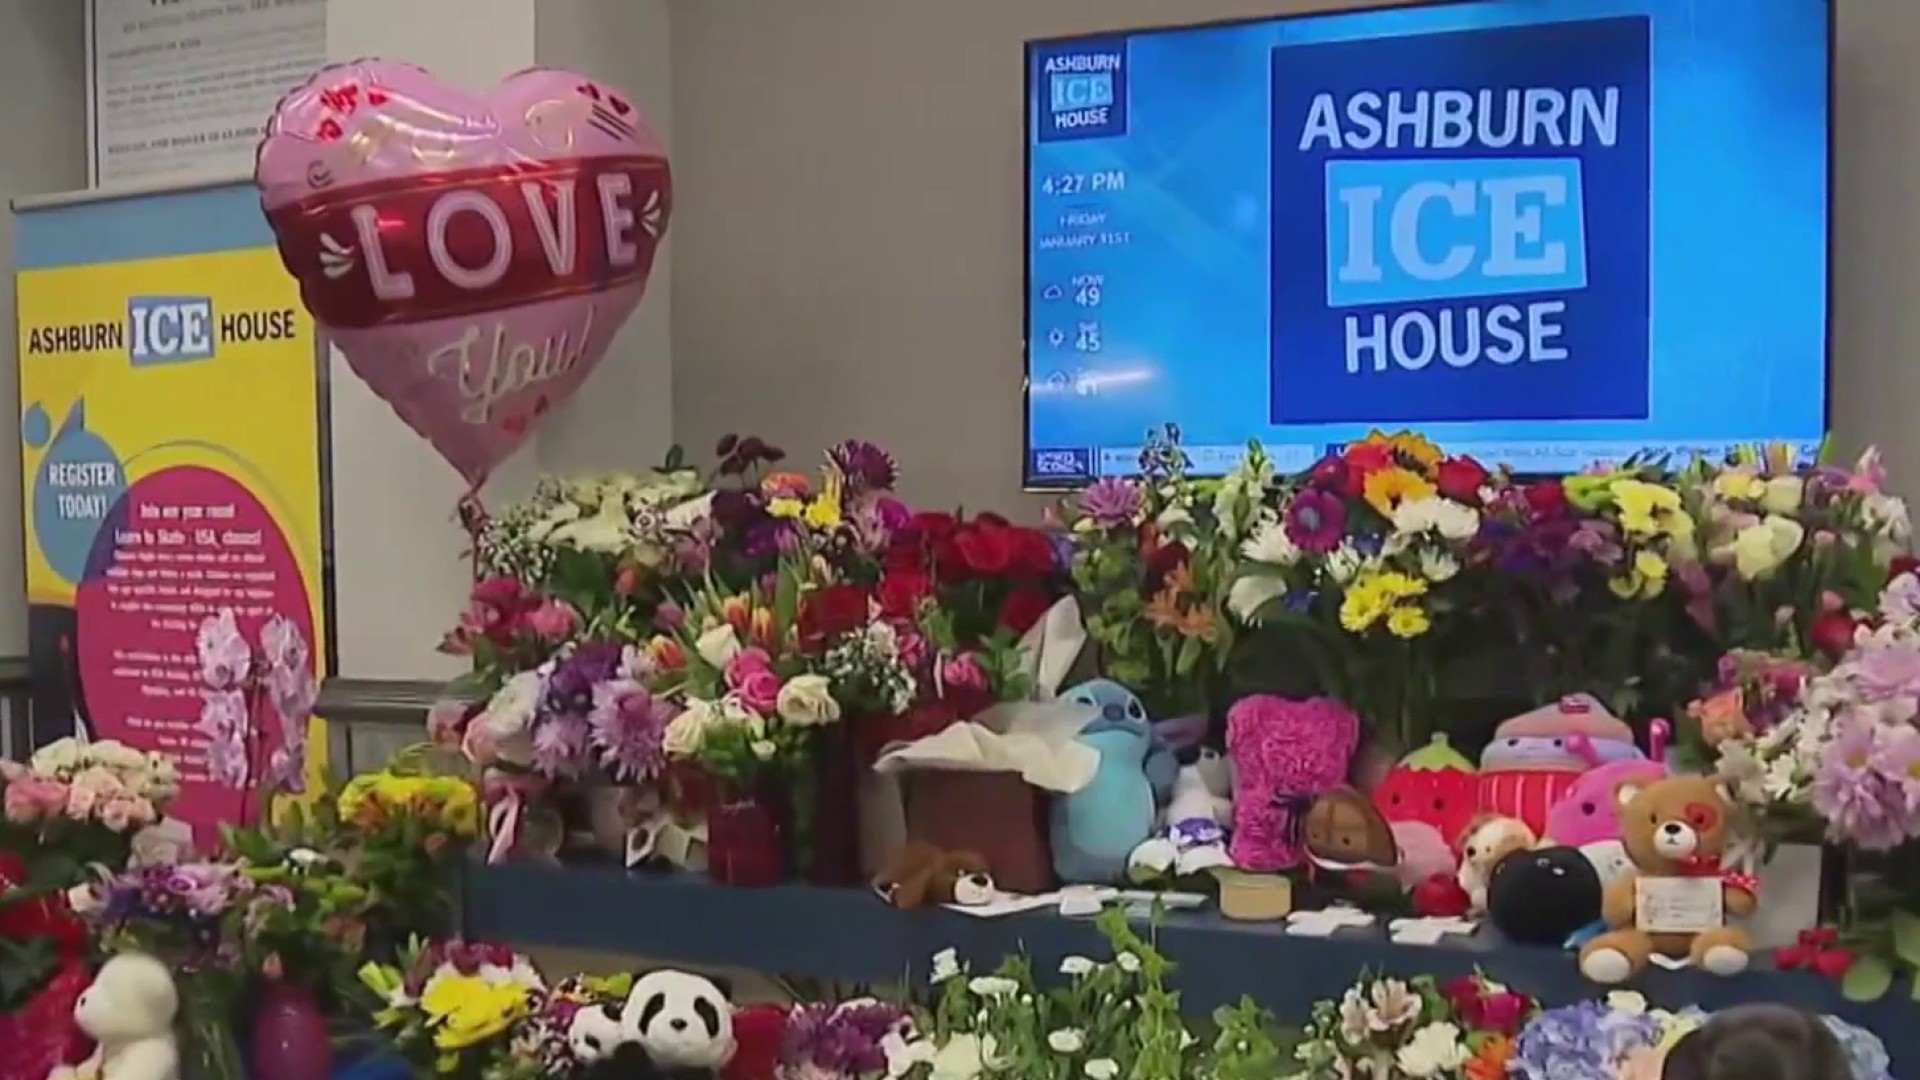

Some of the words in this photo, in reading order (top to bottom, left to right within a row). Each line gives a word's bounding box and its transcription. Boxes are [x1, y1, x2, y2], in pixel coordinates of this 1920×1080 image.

[1045, 53, 1120, 73] ASHBURN
[1055, 78, 1109, 107] ICE
[1055, 107, 1109, 129] HOUSE
[1299, 87, 1619, 151] ASHBURN
[1043, 174, 1085, 195] 4:27
[1092, 170, 1125, 191] PM
[351, 172, 638, 300] LOVE
[1338, 175, 1568, 283] ICE
[1075, 287, 1101, 307] 49
[28, 321, 124, 354] ASHBURN
[131, 302, 210, 357] ICE
[221, 309, 296, 342] HOUSE
[1075, 332, 1101, 351] 45
[1345, 301, 1568, 374] HOUSE
[427, 301, 598, 425] You!
[49, 462, 116, 487] REGISTER
[57, 495, 107, 520] TODAY!
